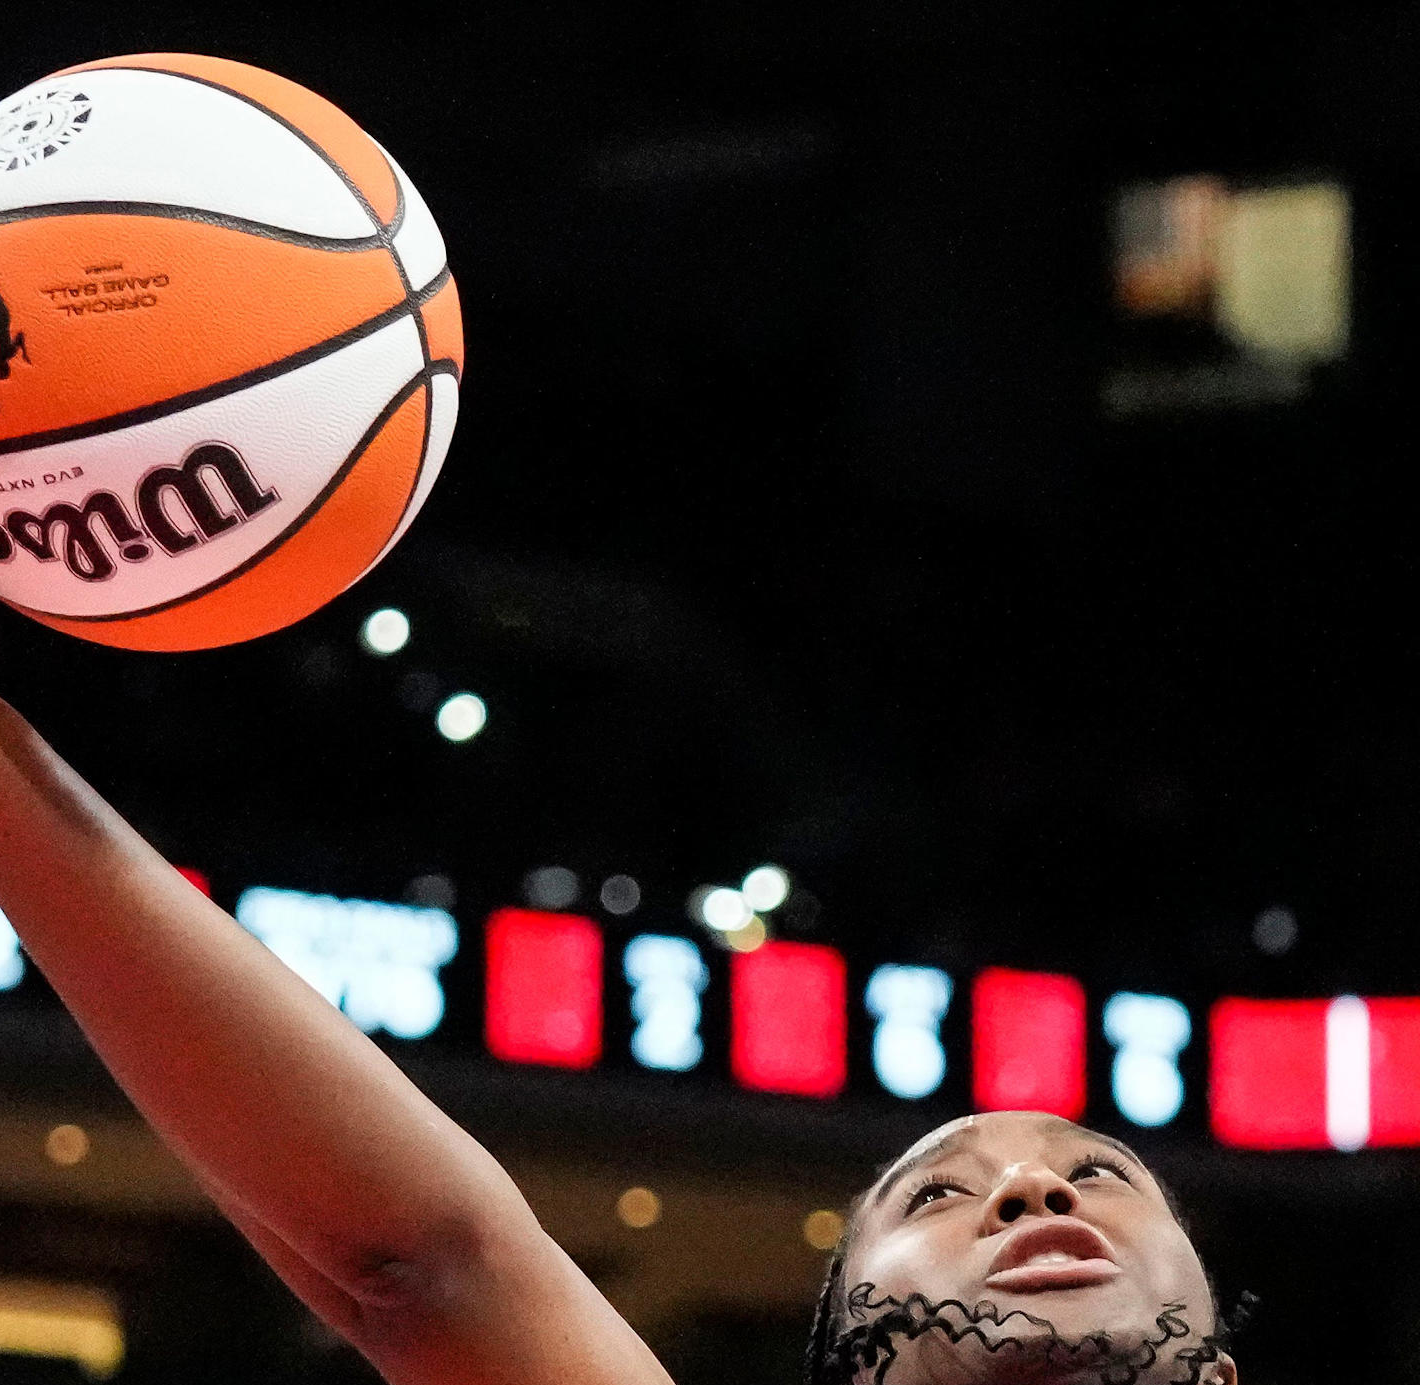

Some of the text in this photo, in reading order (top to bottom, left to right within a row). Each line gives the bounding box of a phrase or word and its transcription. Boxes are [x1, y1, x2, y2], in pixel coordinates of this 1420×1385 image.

[39, 273, 170, 301] GAME BALL
[42, 466, 84, 486] EVO
